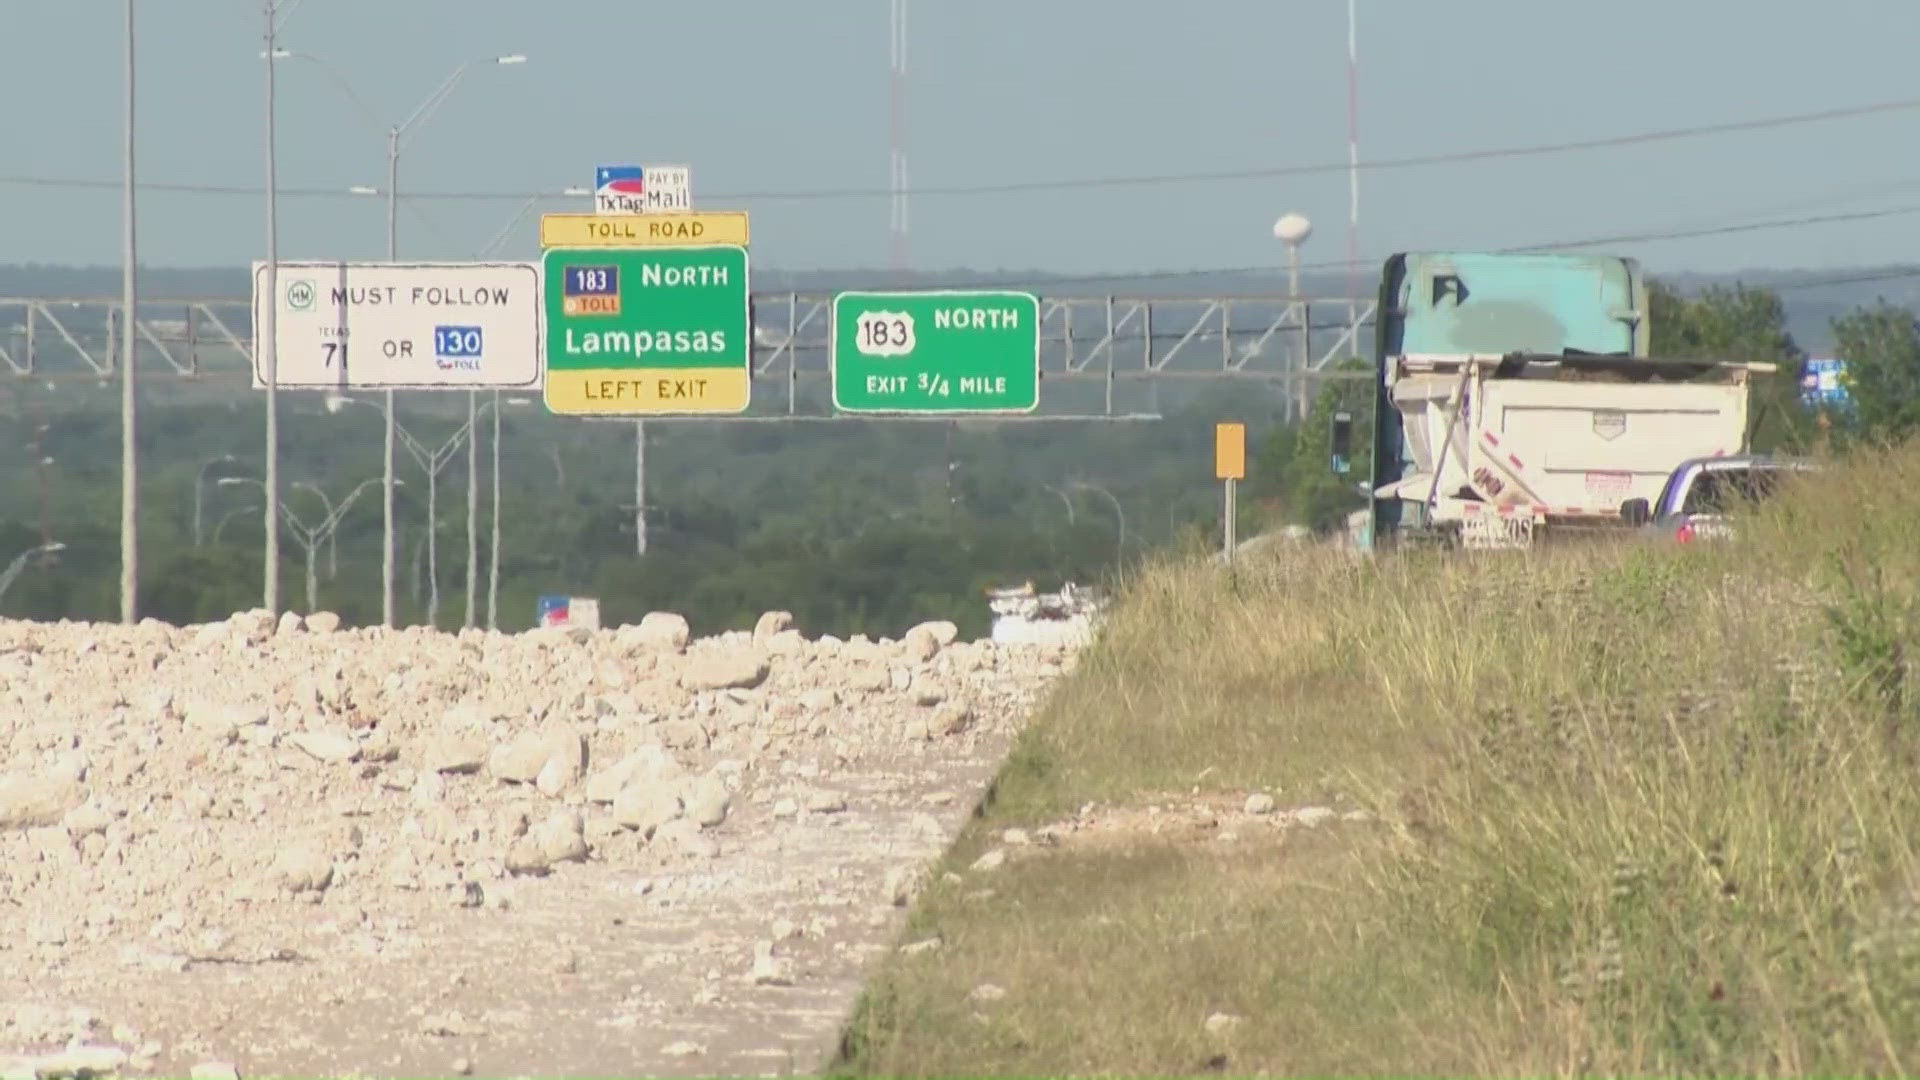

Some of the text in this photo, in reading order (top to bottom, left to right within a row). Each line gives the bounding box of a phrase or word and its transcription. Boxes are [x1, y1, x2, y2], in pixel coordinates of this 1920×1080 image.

[649, 172, 684, 184] PAY BY
[598, 195, 644, 213] TxTag
[648, 190, 688, 208] Mail
[587, 222, 704, 238] TOLL ROAD
[577, 271, 606, 291] 183
[641, 263, 728, 287] NORTH
[331, 287, 509, 306] MUST FOLLOW
[580, 298, 618, 312] TOLL
[935, 308, 1018, 329] NORTH
[437, 330, 480, 353] 130
[565, 328, 726, 358] Lampasas
[864, 320, 907, 346] 183
[321, 343, 348, 370] 71
[382, 340, 413, 358] OR
[584, 379, 707, 399] LEFT EXIT
[866, 372, 1006, 397] EXIT 3/4 MILE
